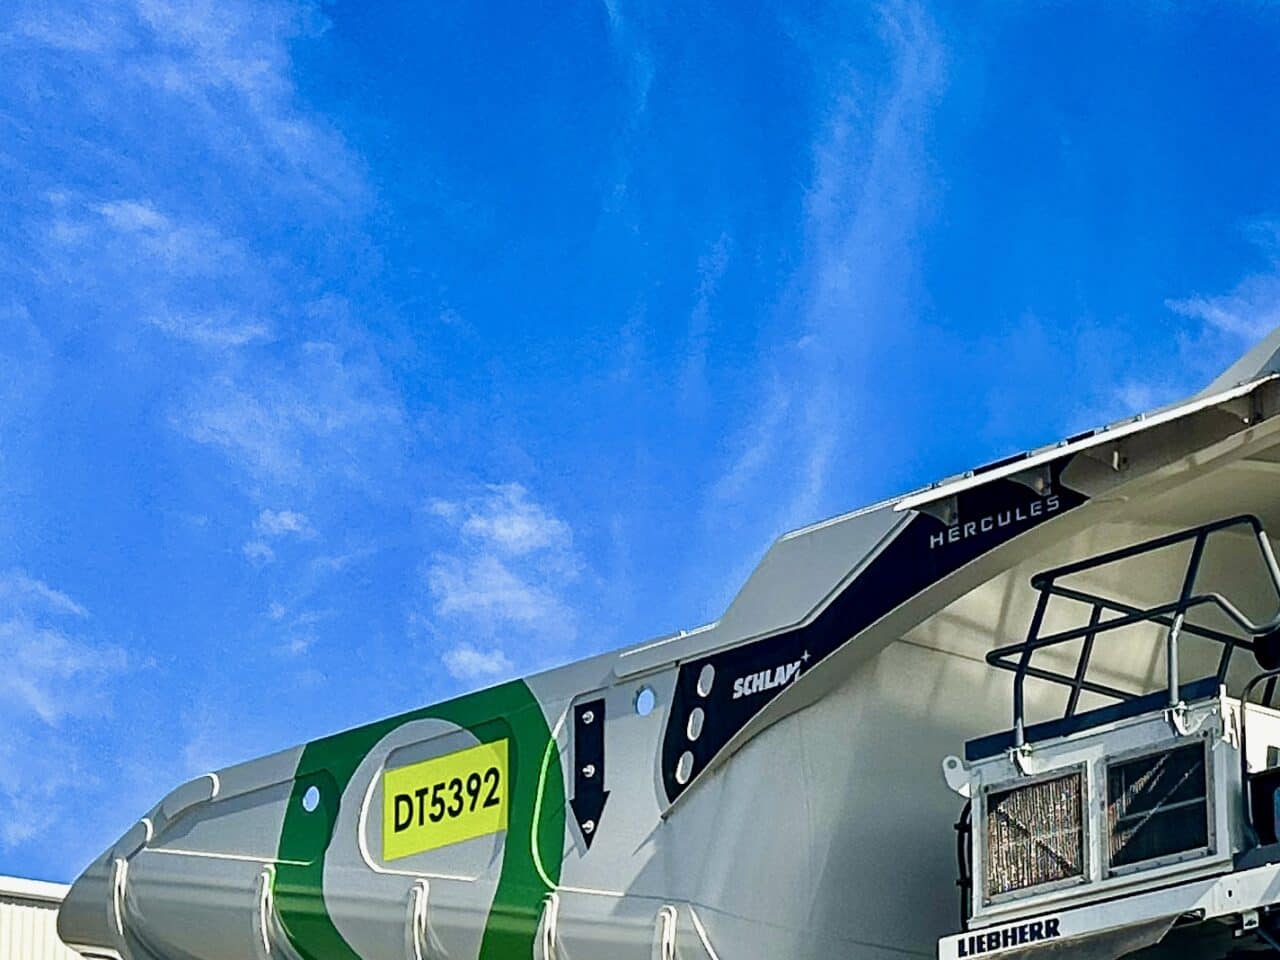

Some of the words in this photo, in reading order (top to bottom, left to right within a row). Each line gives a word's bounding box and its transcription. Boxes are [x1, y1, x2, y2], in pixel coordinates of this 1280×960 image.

[929, 495, 1060, 549] HERCULES
[394, 767, 500, 833] DT5392
[958, 918, 1060, 958] LIEBHERR
